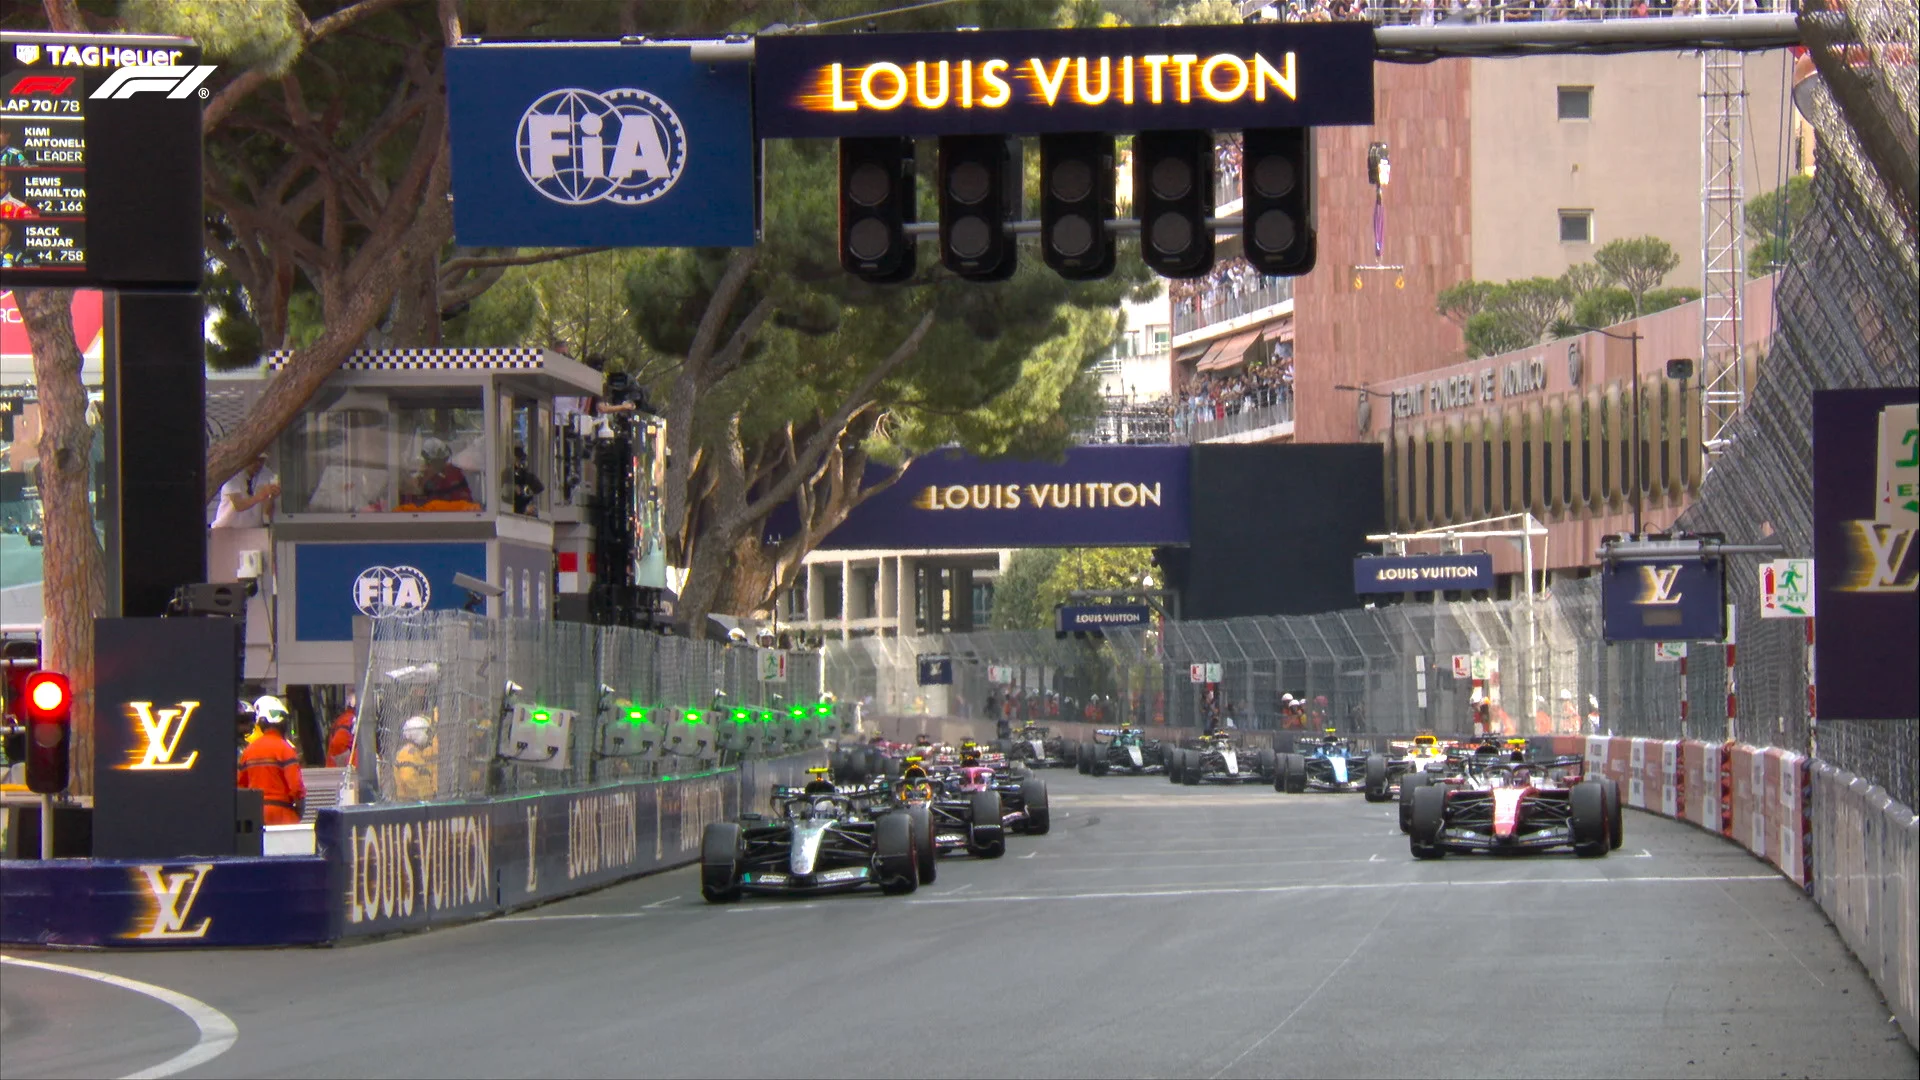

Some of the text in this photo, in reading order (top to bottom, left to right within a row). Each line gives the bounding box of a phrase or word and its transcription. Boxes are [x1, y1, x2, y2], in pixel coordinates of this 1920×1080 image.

[831, 51, 1297, 111] LOUIS VUITTON
[0, 99, 29, 112] LAP
[25, 127, 51, 137] KIMI
[36, 151, 83, 161] LEADER
[25, 177, 61, 186] LEWIS
[37, 201, 83, 212] +2.166
[26, 227, 60, 236] ISACK
[26, 238, 74, 247] HADJAR
[38, 250, 84, 261] +4.758
[1480, 367, 1496, 401] DE
[930, 481, 1161, 510] LOUIS VUITTON
[1378, 565, 1478, 581] LOUIS VUITTON
[1076, 613, 1140, 623] LOUIS VUITTON
[568, 796, 599, 880] LOUIS
[600, 790, 637, 869] VUITTON
[352, 813, 489, 924] LOUIS VUITTON
